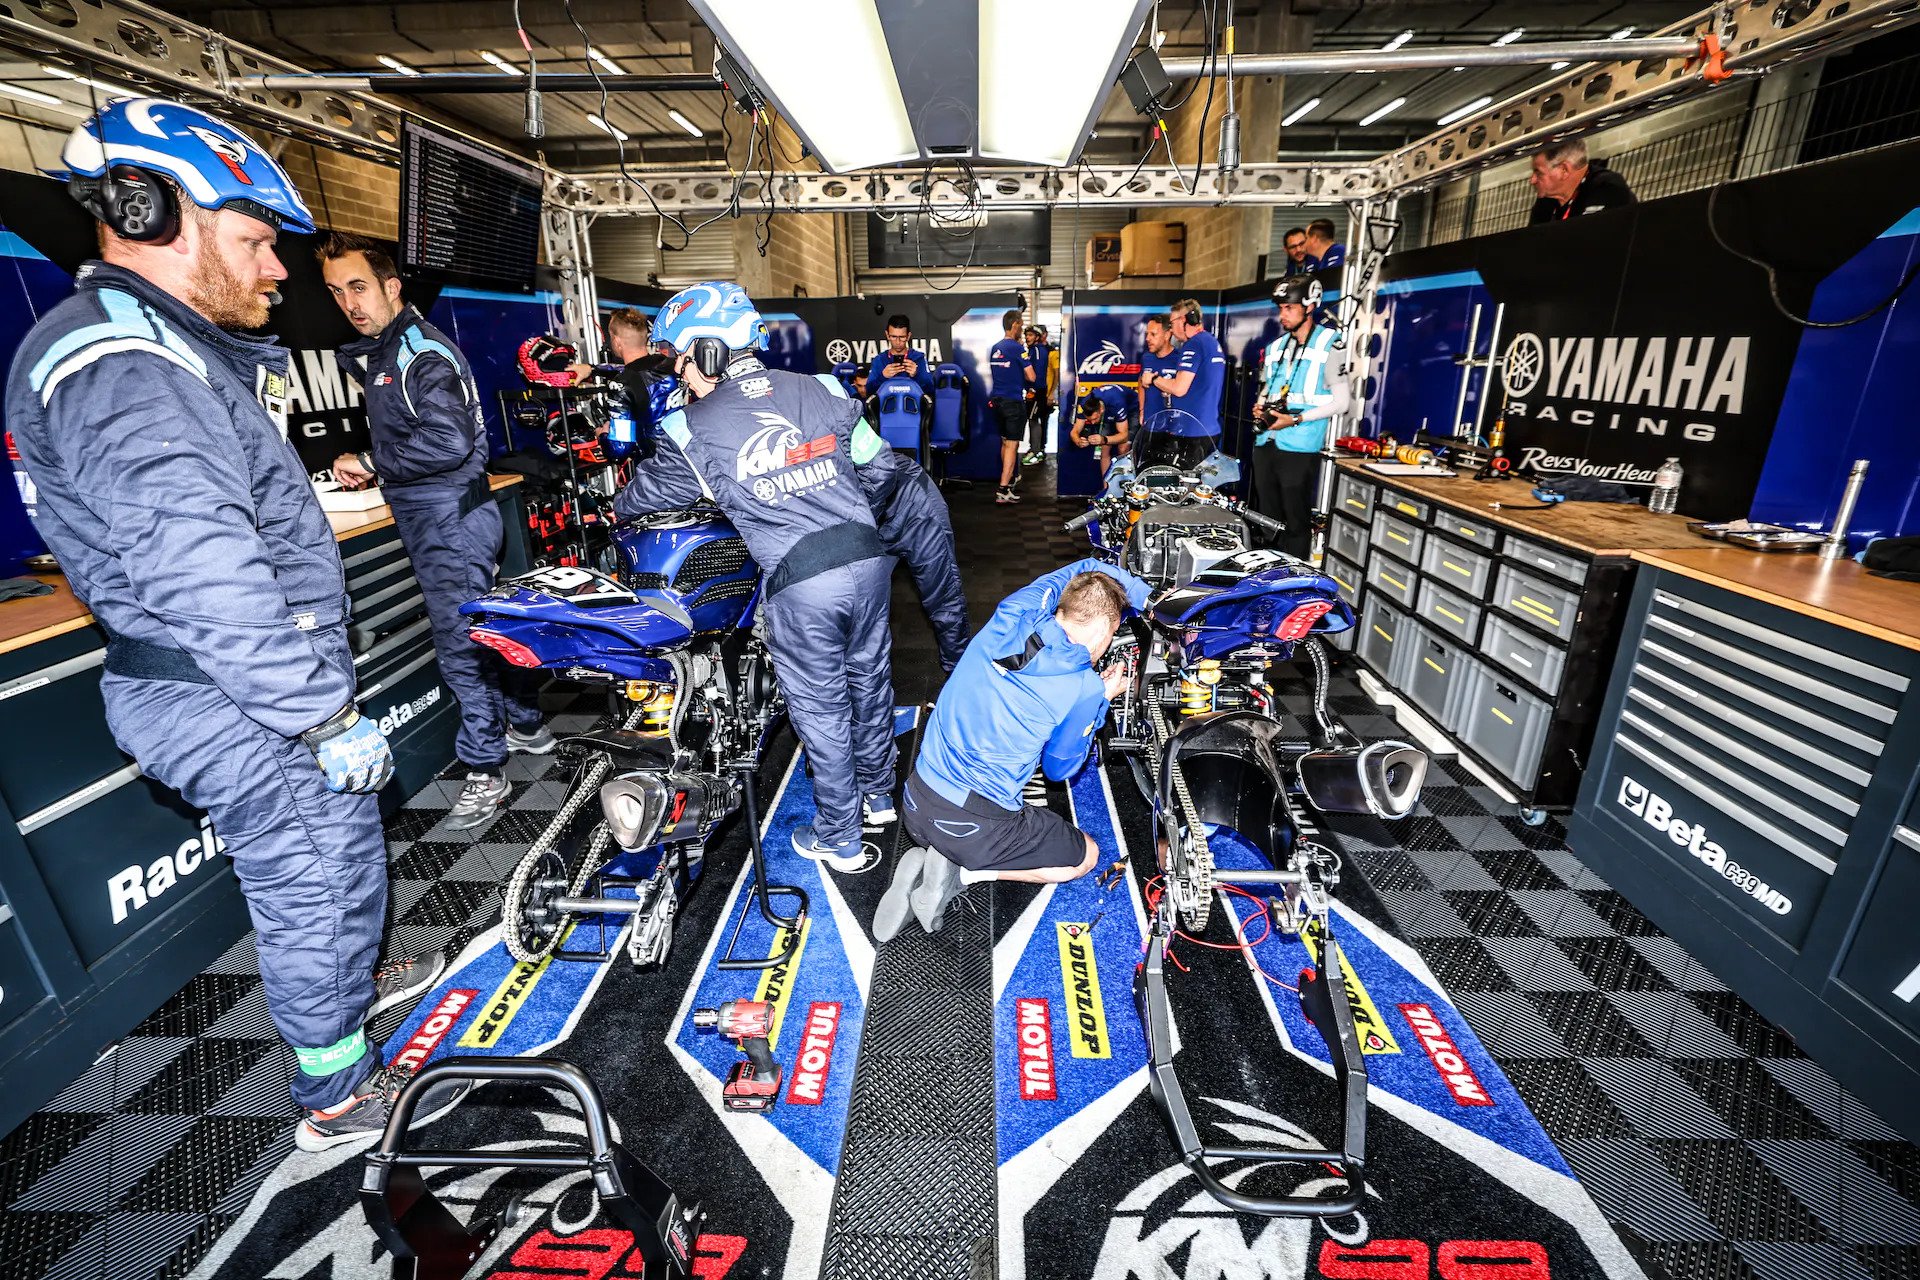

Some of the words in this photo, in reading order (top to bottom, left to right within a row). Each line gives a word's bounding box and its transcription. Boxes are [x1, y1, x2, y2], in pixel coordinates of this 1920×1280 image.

[1096, 252, 1120, 261] Cryst
[1546, 336, 1751, 415] YAMAHA
[1508, 402, 1717, 442] RACING
[771, 458, 839, 493] YAMAHA
[1614, 463, 1659, 484] Hear
[106, 815, 230, 925] Raci
[1643, 793, 1728, 875] Beta
[399, 992, 469, 1071] MOTU
[1067, 941, 1102, 1056] DUNLOP
[795, 1004, 839, 1101] MOTUL
[1018, 1001, 1053, 1096] MOTUL
[1407, 1006, 1485, 1102] MOTUL
